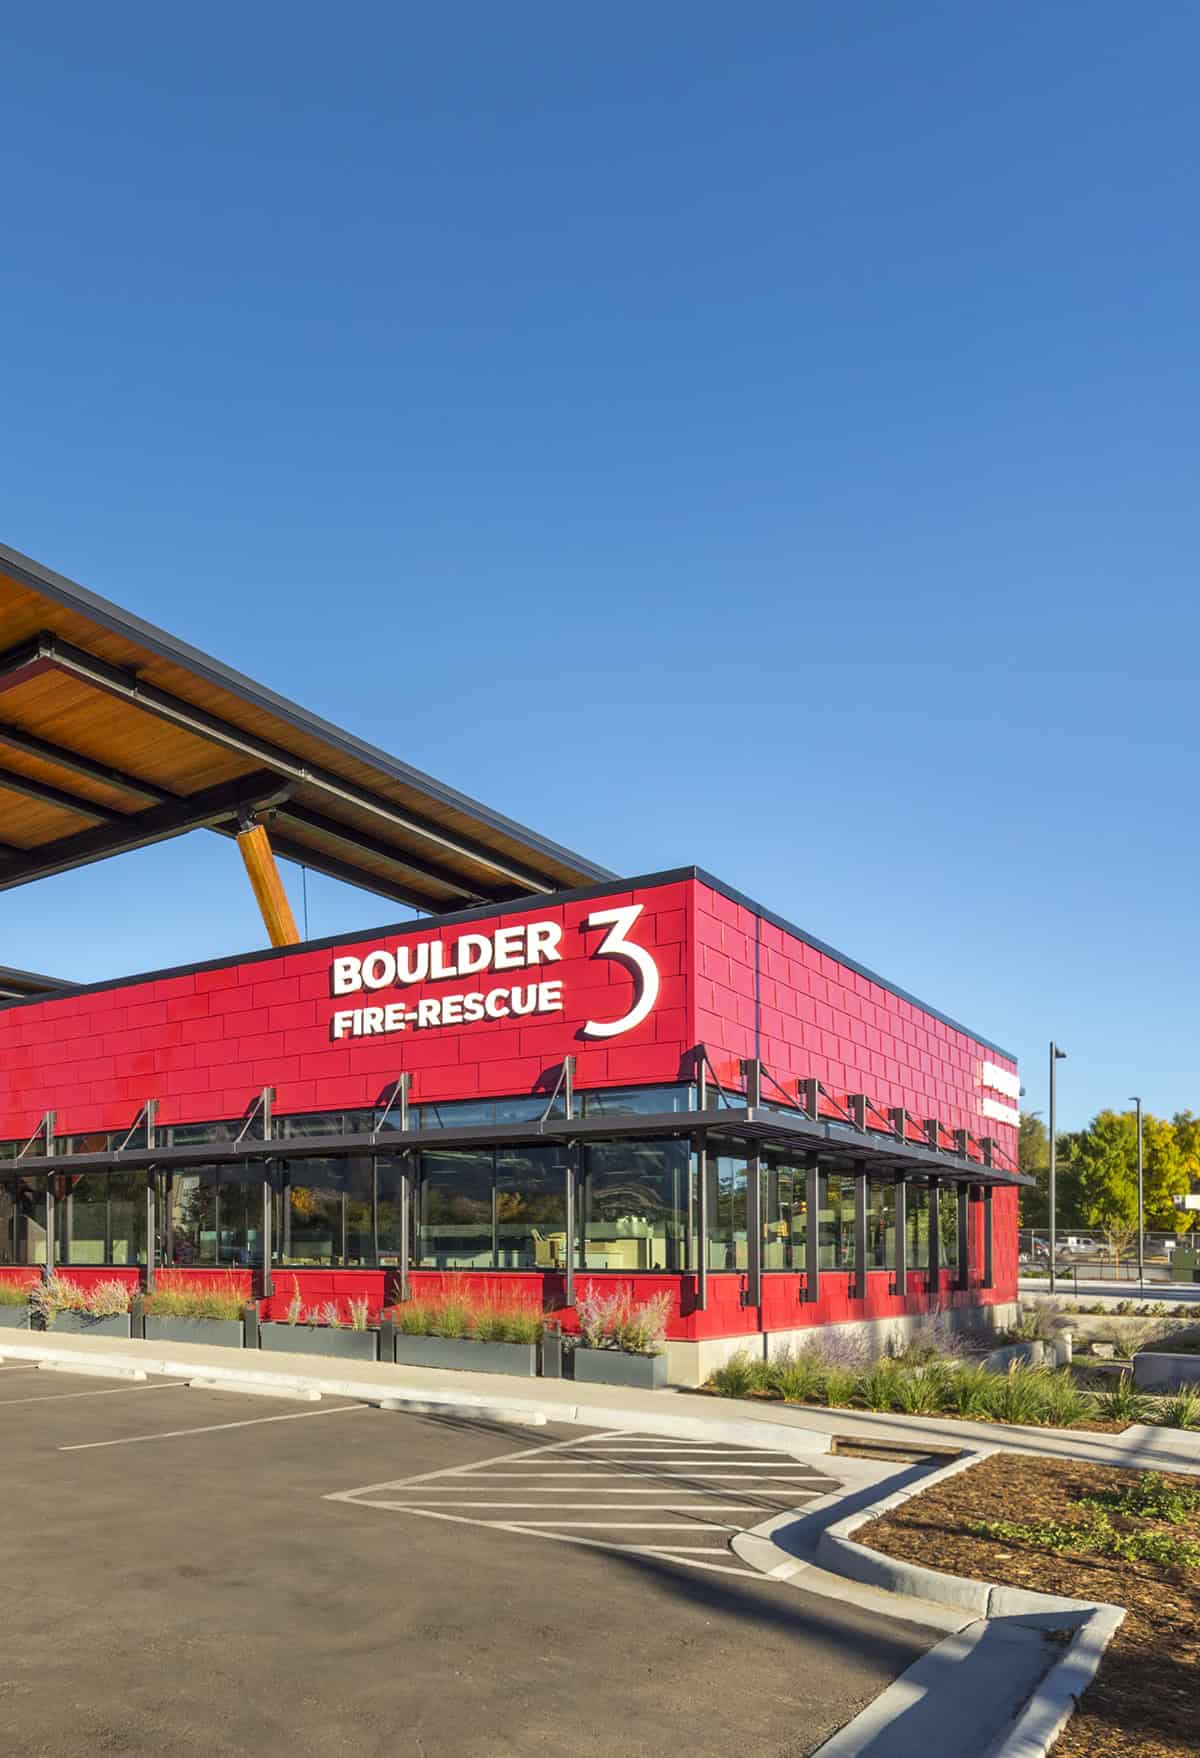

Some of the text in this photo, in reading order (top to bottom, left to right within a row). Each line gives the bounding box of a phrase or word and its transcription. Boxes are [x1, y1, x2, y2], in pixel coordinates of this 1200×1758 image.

[334, 921, 563, 995] BOULDER
[583, 904, 660, 1037] 3
[334, 980, 563, 1038] FIRE-RESCUE
